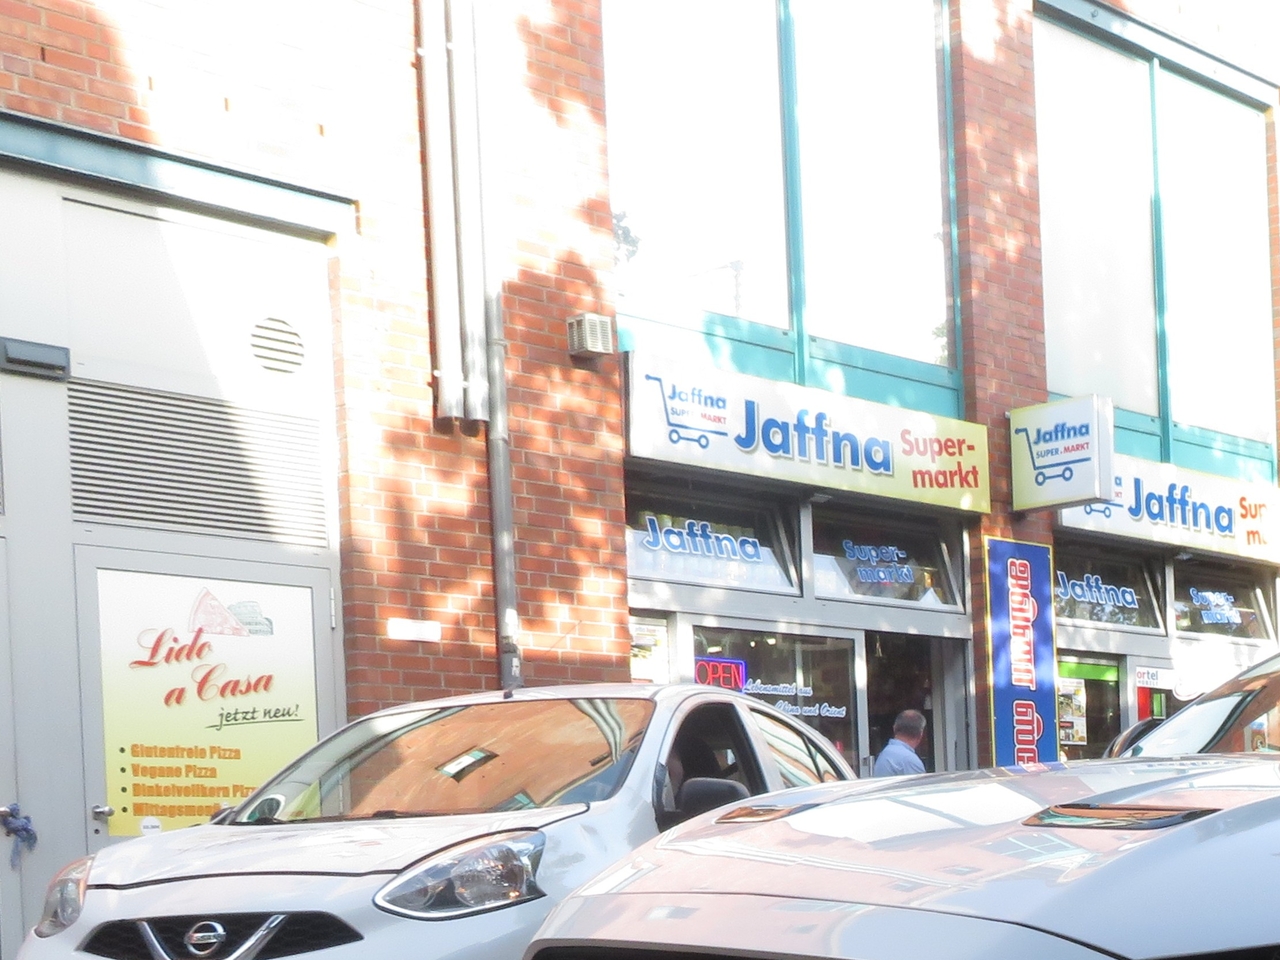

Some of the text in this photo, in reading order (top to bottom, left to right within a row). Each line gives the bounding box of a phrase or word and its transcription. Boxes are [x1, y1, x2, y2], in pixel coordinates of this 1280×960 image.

[667, 383, 727, 410] Jaffna
[734, 399, 893, 474] Jaffna
[900, 429, 975, 463] Super-
[1033, 423, 1090, 445] Jaffna
[912, 463, 979, 489] markt
[1128, 476, 1235, 534] Jaffna
[643, 515, 762, 562] Jaffna
[843, 540, 907, 564] Super-
[857, 563, 915, 584] markt
[1055, 570, 1139, 609] Jaffna
[129, 627, 213, 668] Lido
[164, 663, 274, 707] a Casa
[695, 660, 743, 689] OPEN
[742, 678, 813, 696] Lebensmittel aus
[1136, 670, 1159, 681] ortel
[215, 704, 299, 731] jetzt neu!
[802, 703, 819, 716] und
[820, 702, 847, 718] Orient
[209, 746, 241, 760] Pizza
[131, 763, 217, 779] Vegane Pizza
